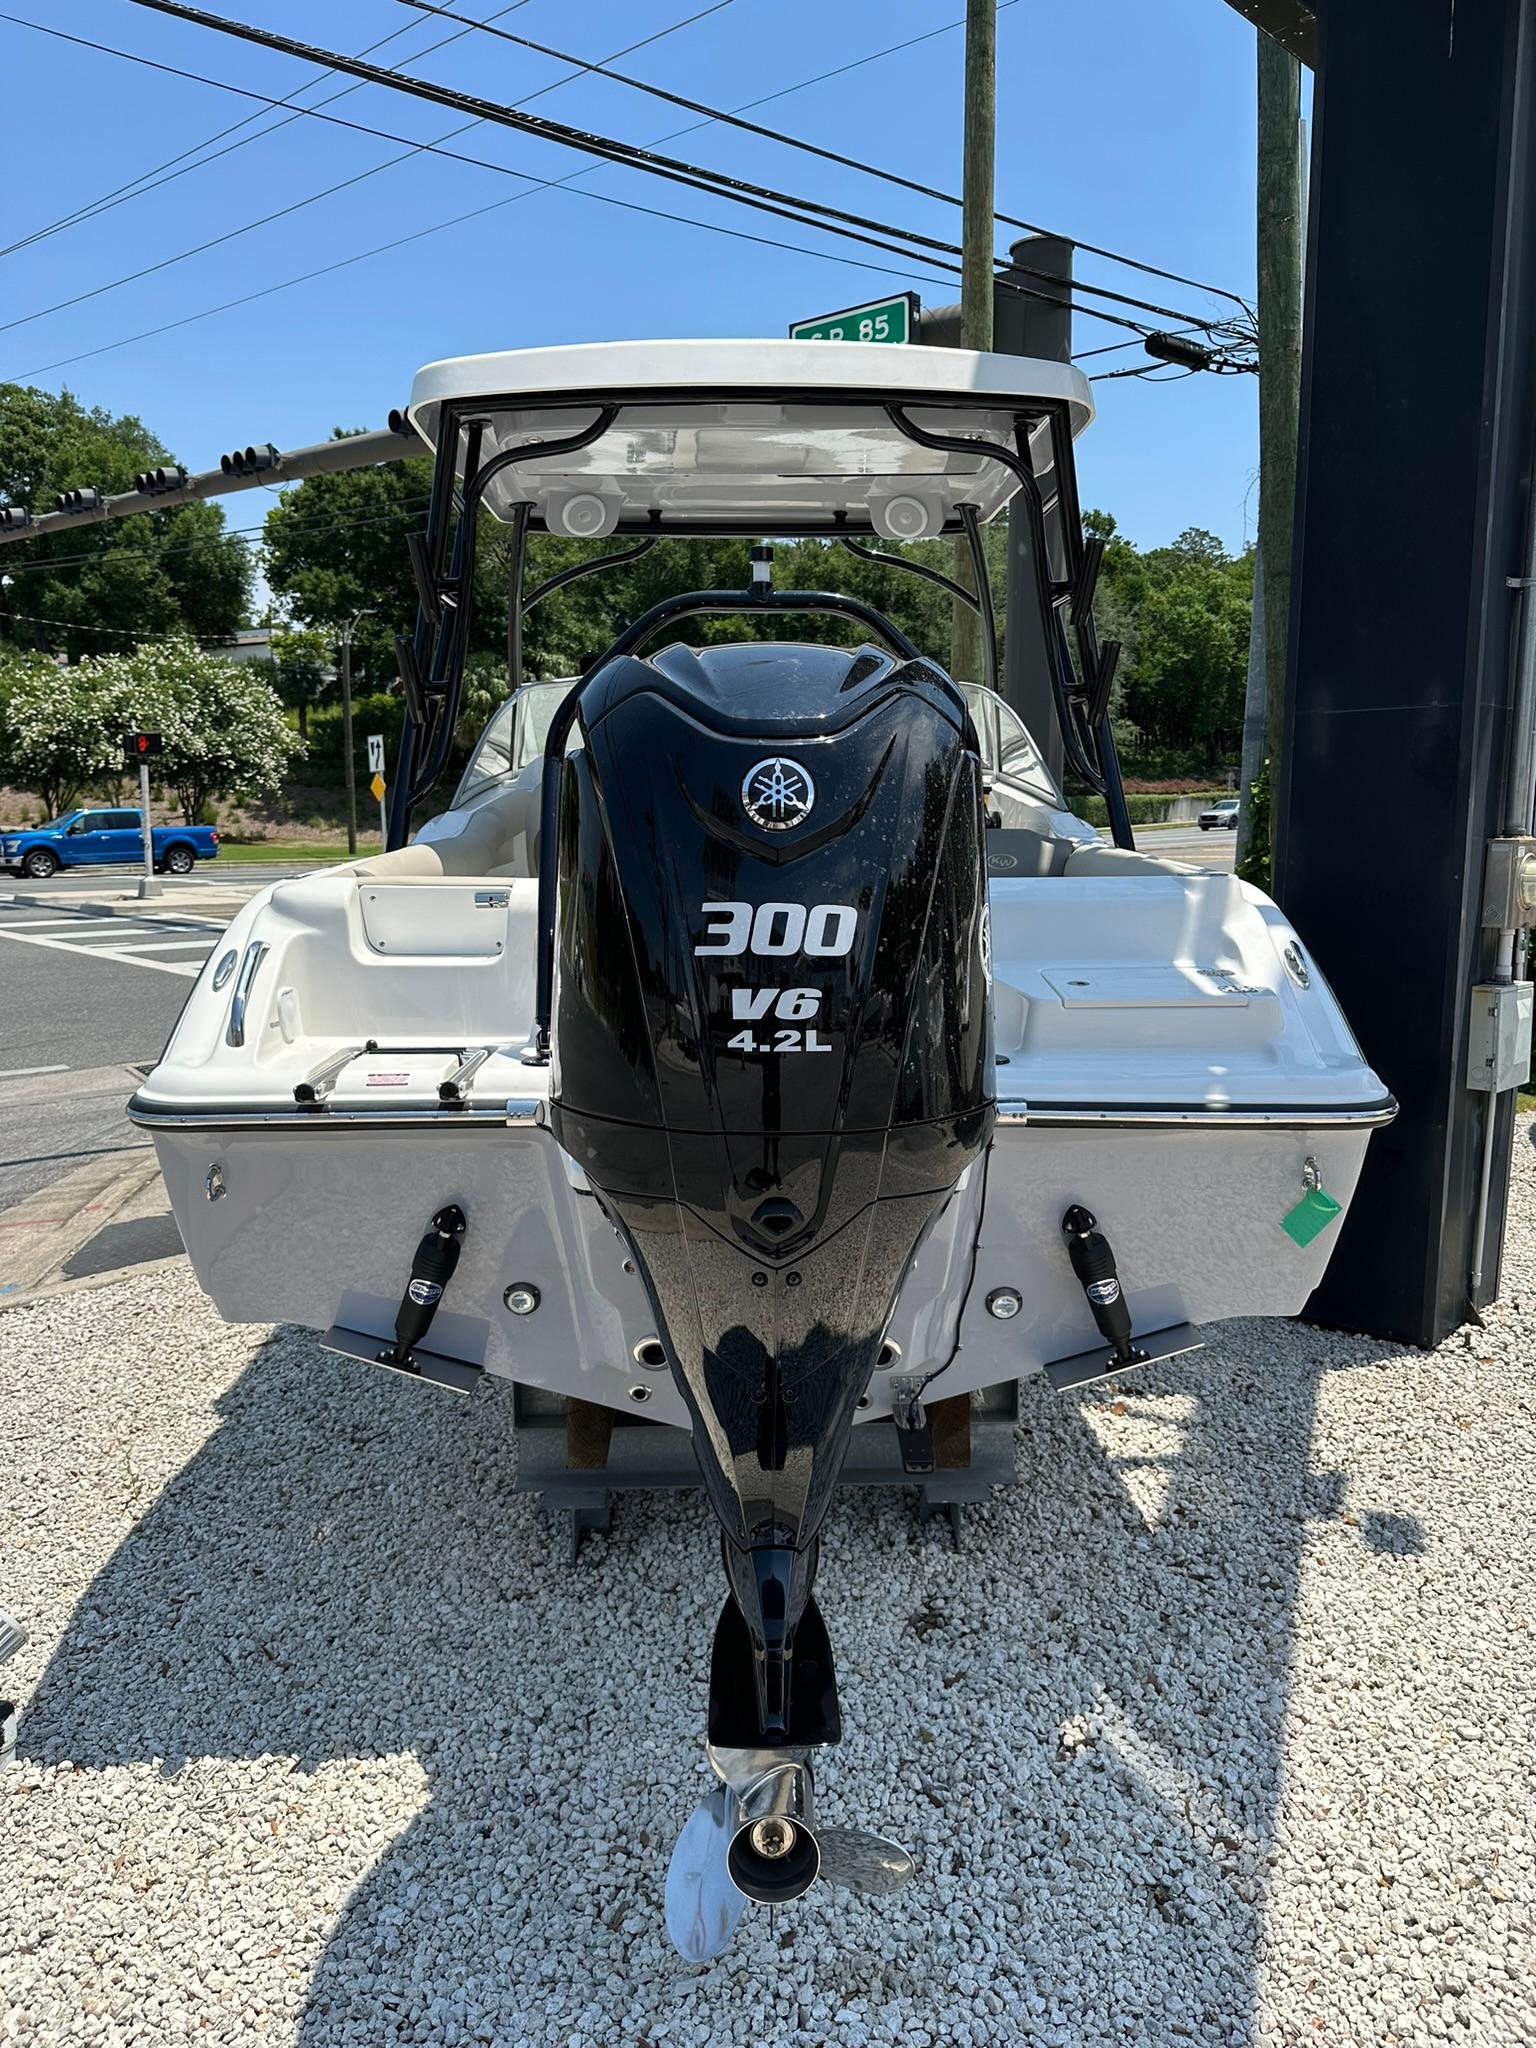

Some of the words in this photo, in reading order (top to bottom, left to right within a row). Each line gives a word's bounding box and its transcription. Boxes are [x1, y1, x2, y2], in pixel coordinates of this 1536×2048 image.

[858, 314, 890, 342] 85
[694, 902, 858, 957] 300
[731, 987, 823, 1020] V6
[727, 1029, 832, 1052] 4.2L
